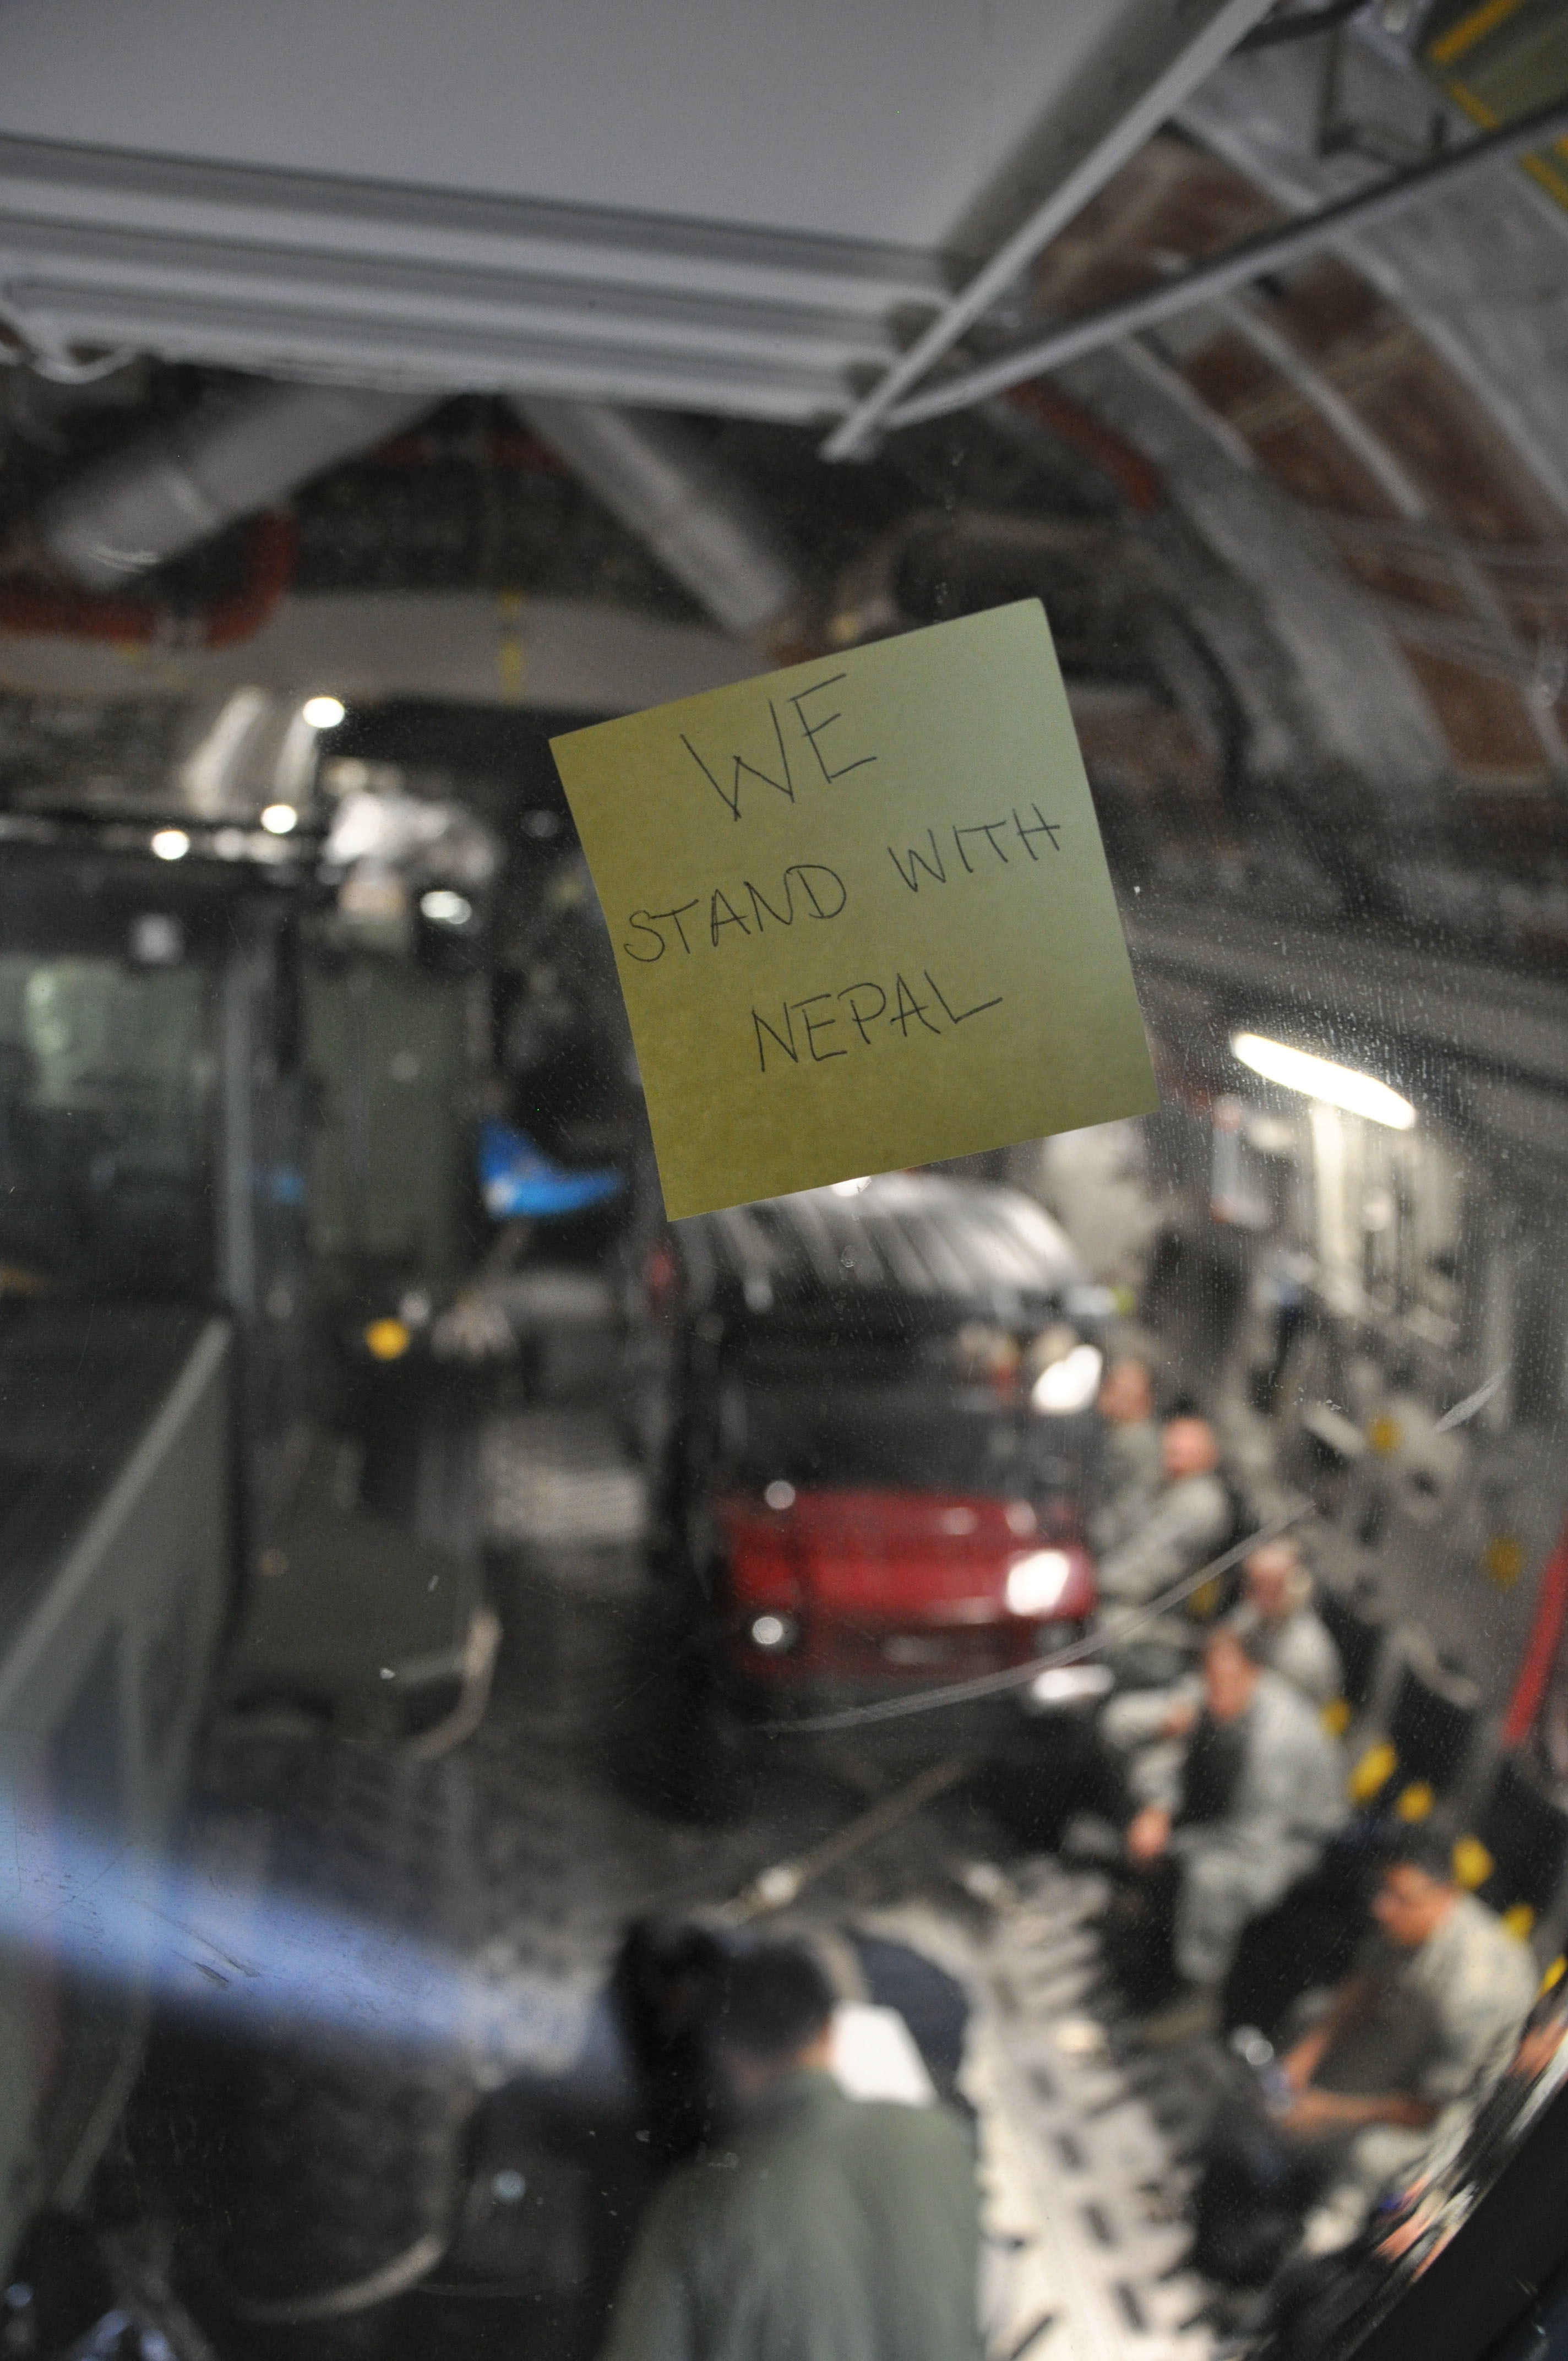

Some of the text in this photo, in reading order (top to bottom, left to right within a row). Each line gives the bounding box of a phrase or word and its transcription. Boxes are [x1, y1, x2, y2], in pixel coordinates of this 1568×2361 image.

[679, 672, 878, 822] WE
[623, 802, 1061, 963] STAND WITH
[750, 969, 1004, 1073] NEPAL
